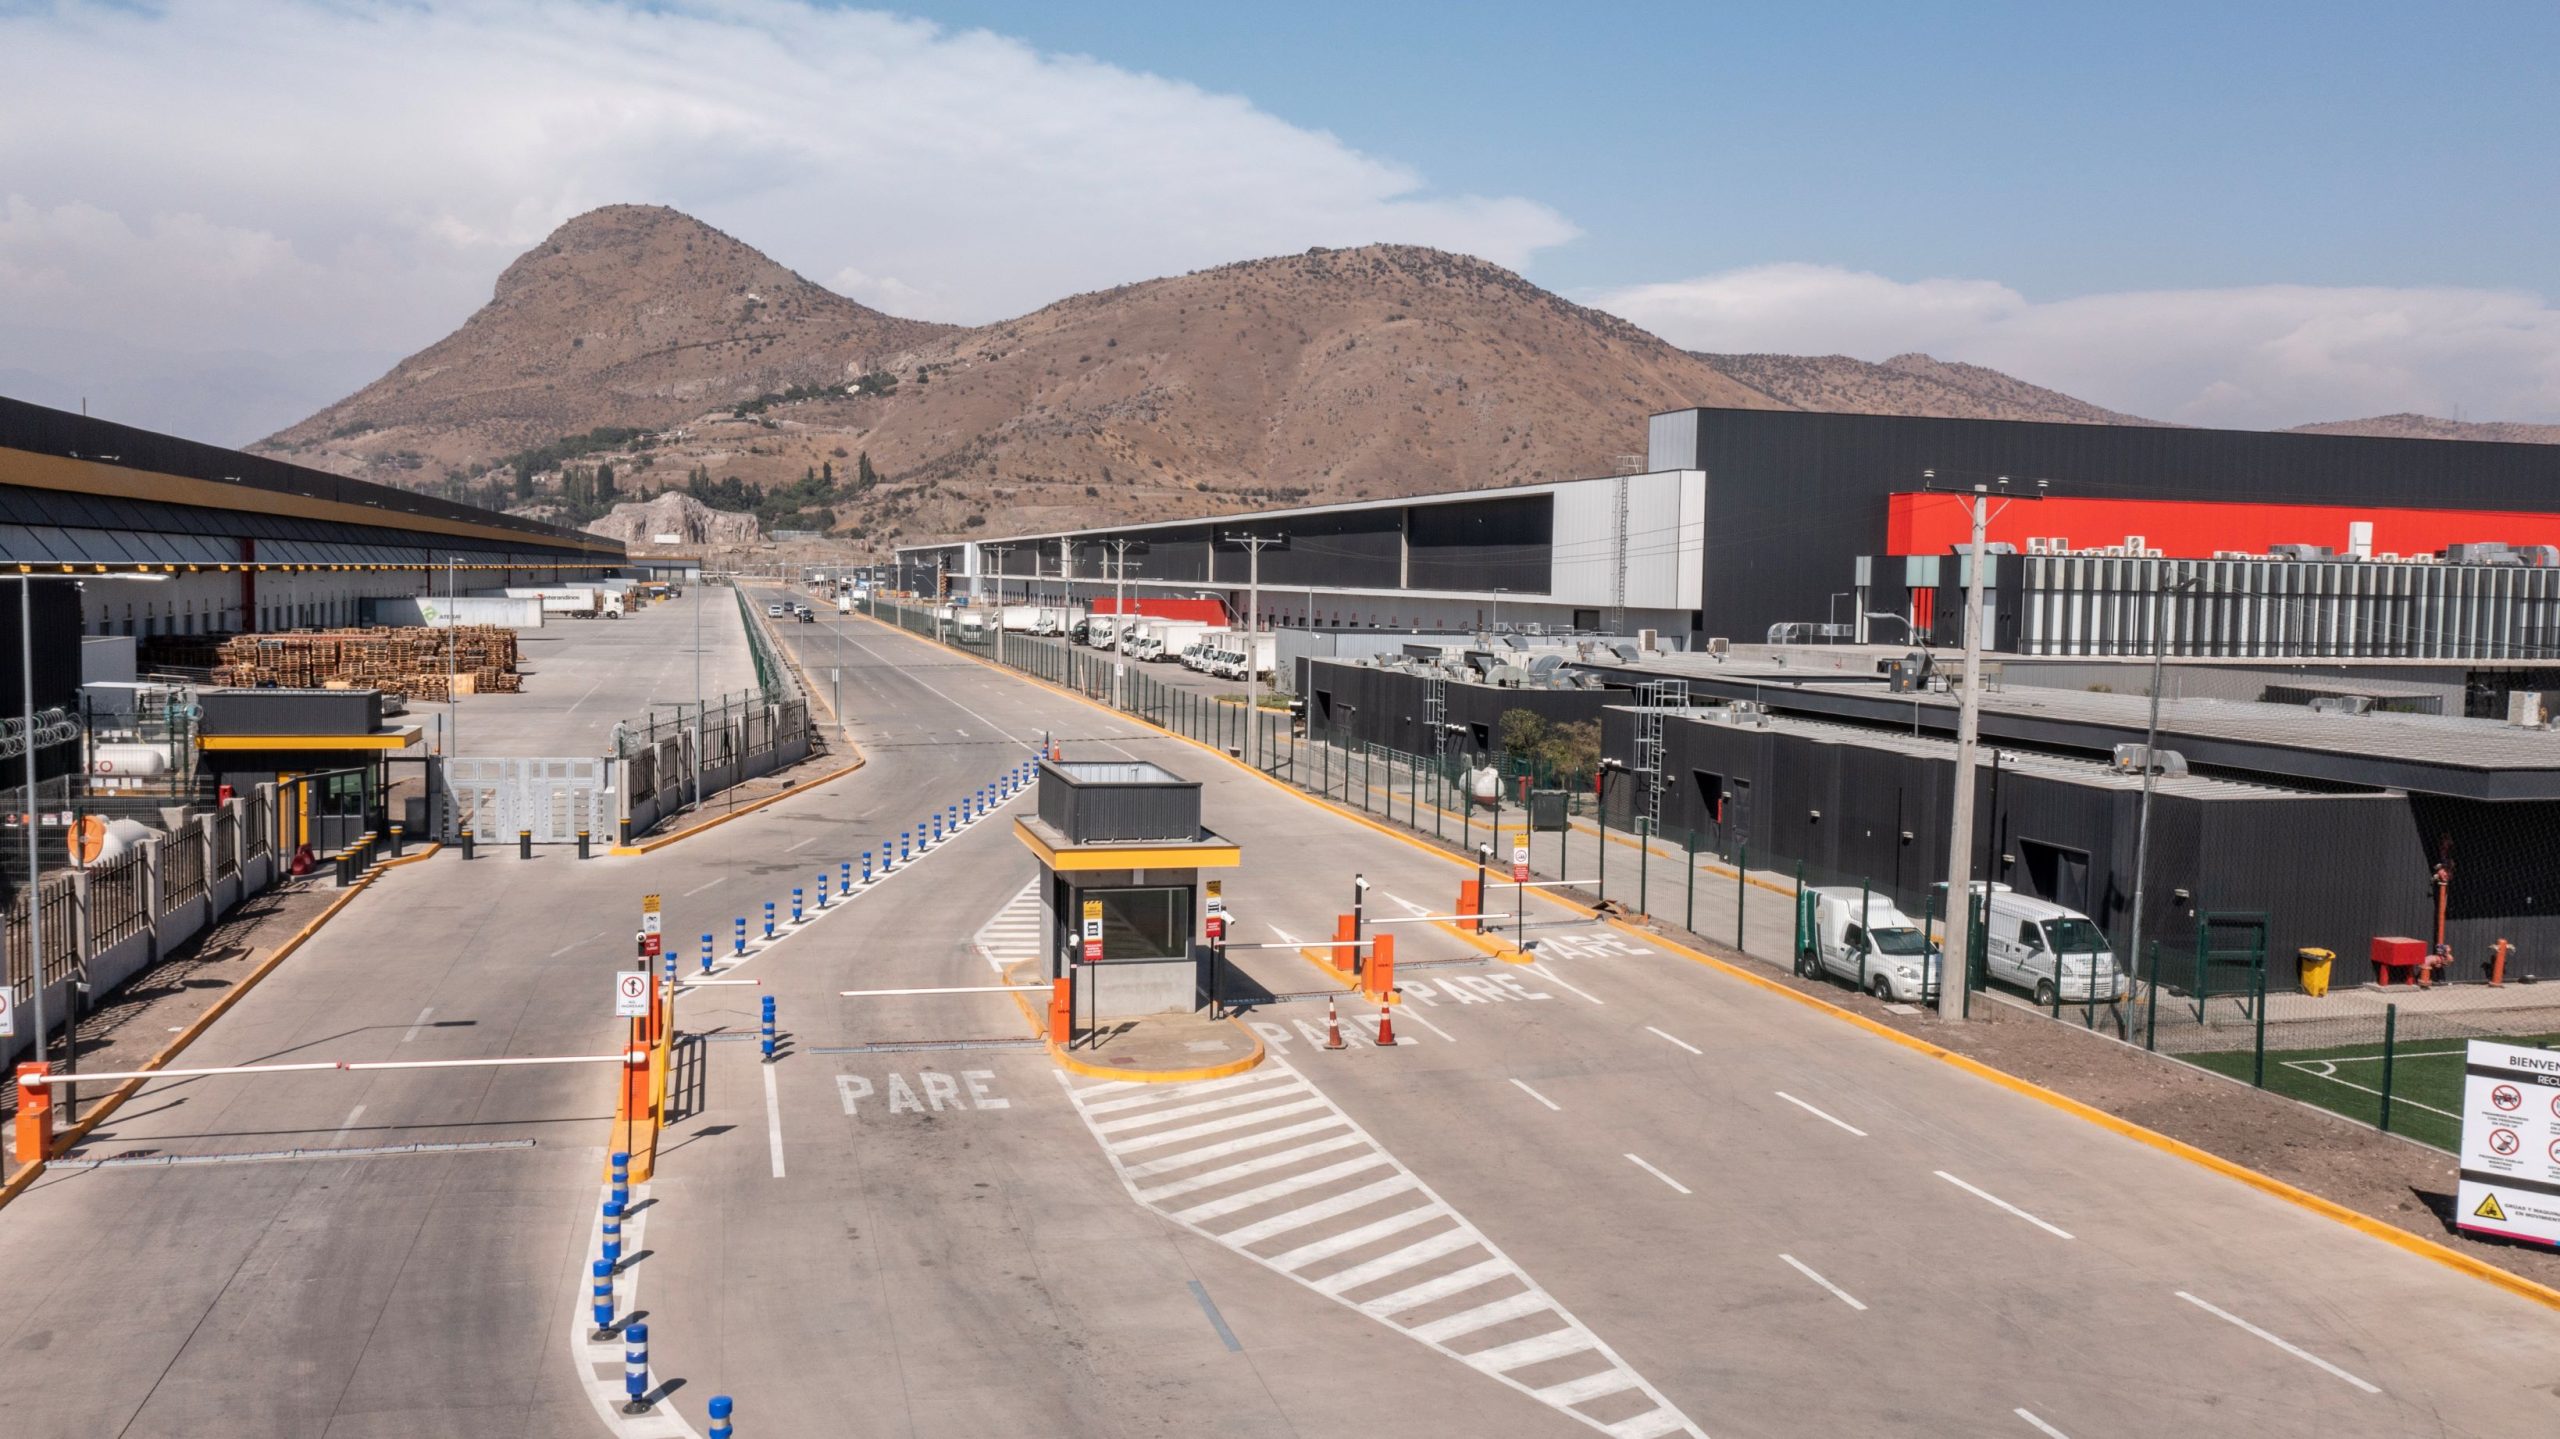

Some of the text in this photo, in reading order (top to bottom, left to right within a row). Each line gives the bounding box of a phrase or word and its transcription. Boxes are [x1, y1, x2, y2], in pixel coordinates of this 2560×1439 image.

[1393, 973, 1554, 1007] PARE
[1248, 1014, 1419, 1055] PARE
[835, 1069, 1011, 1115] PARE
